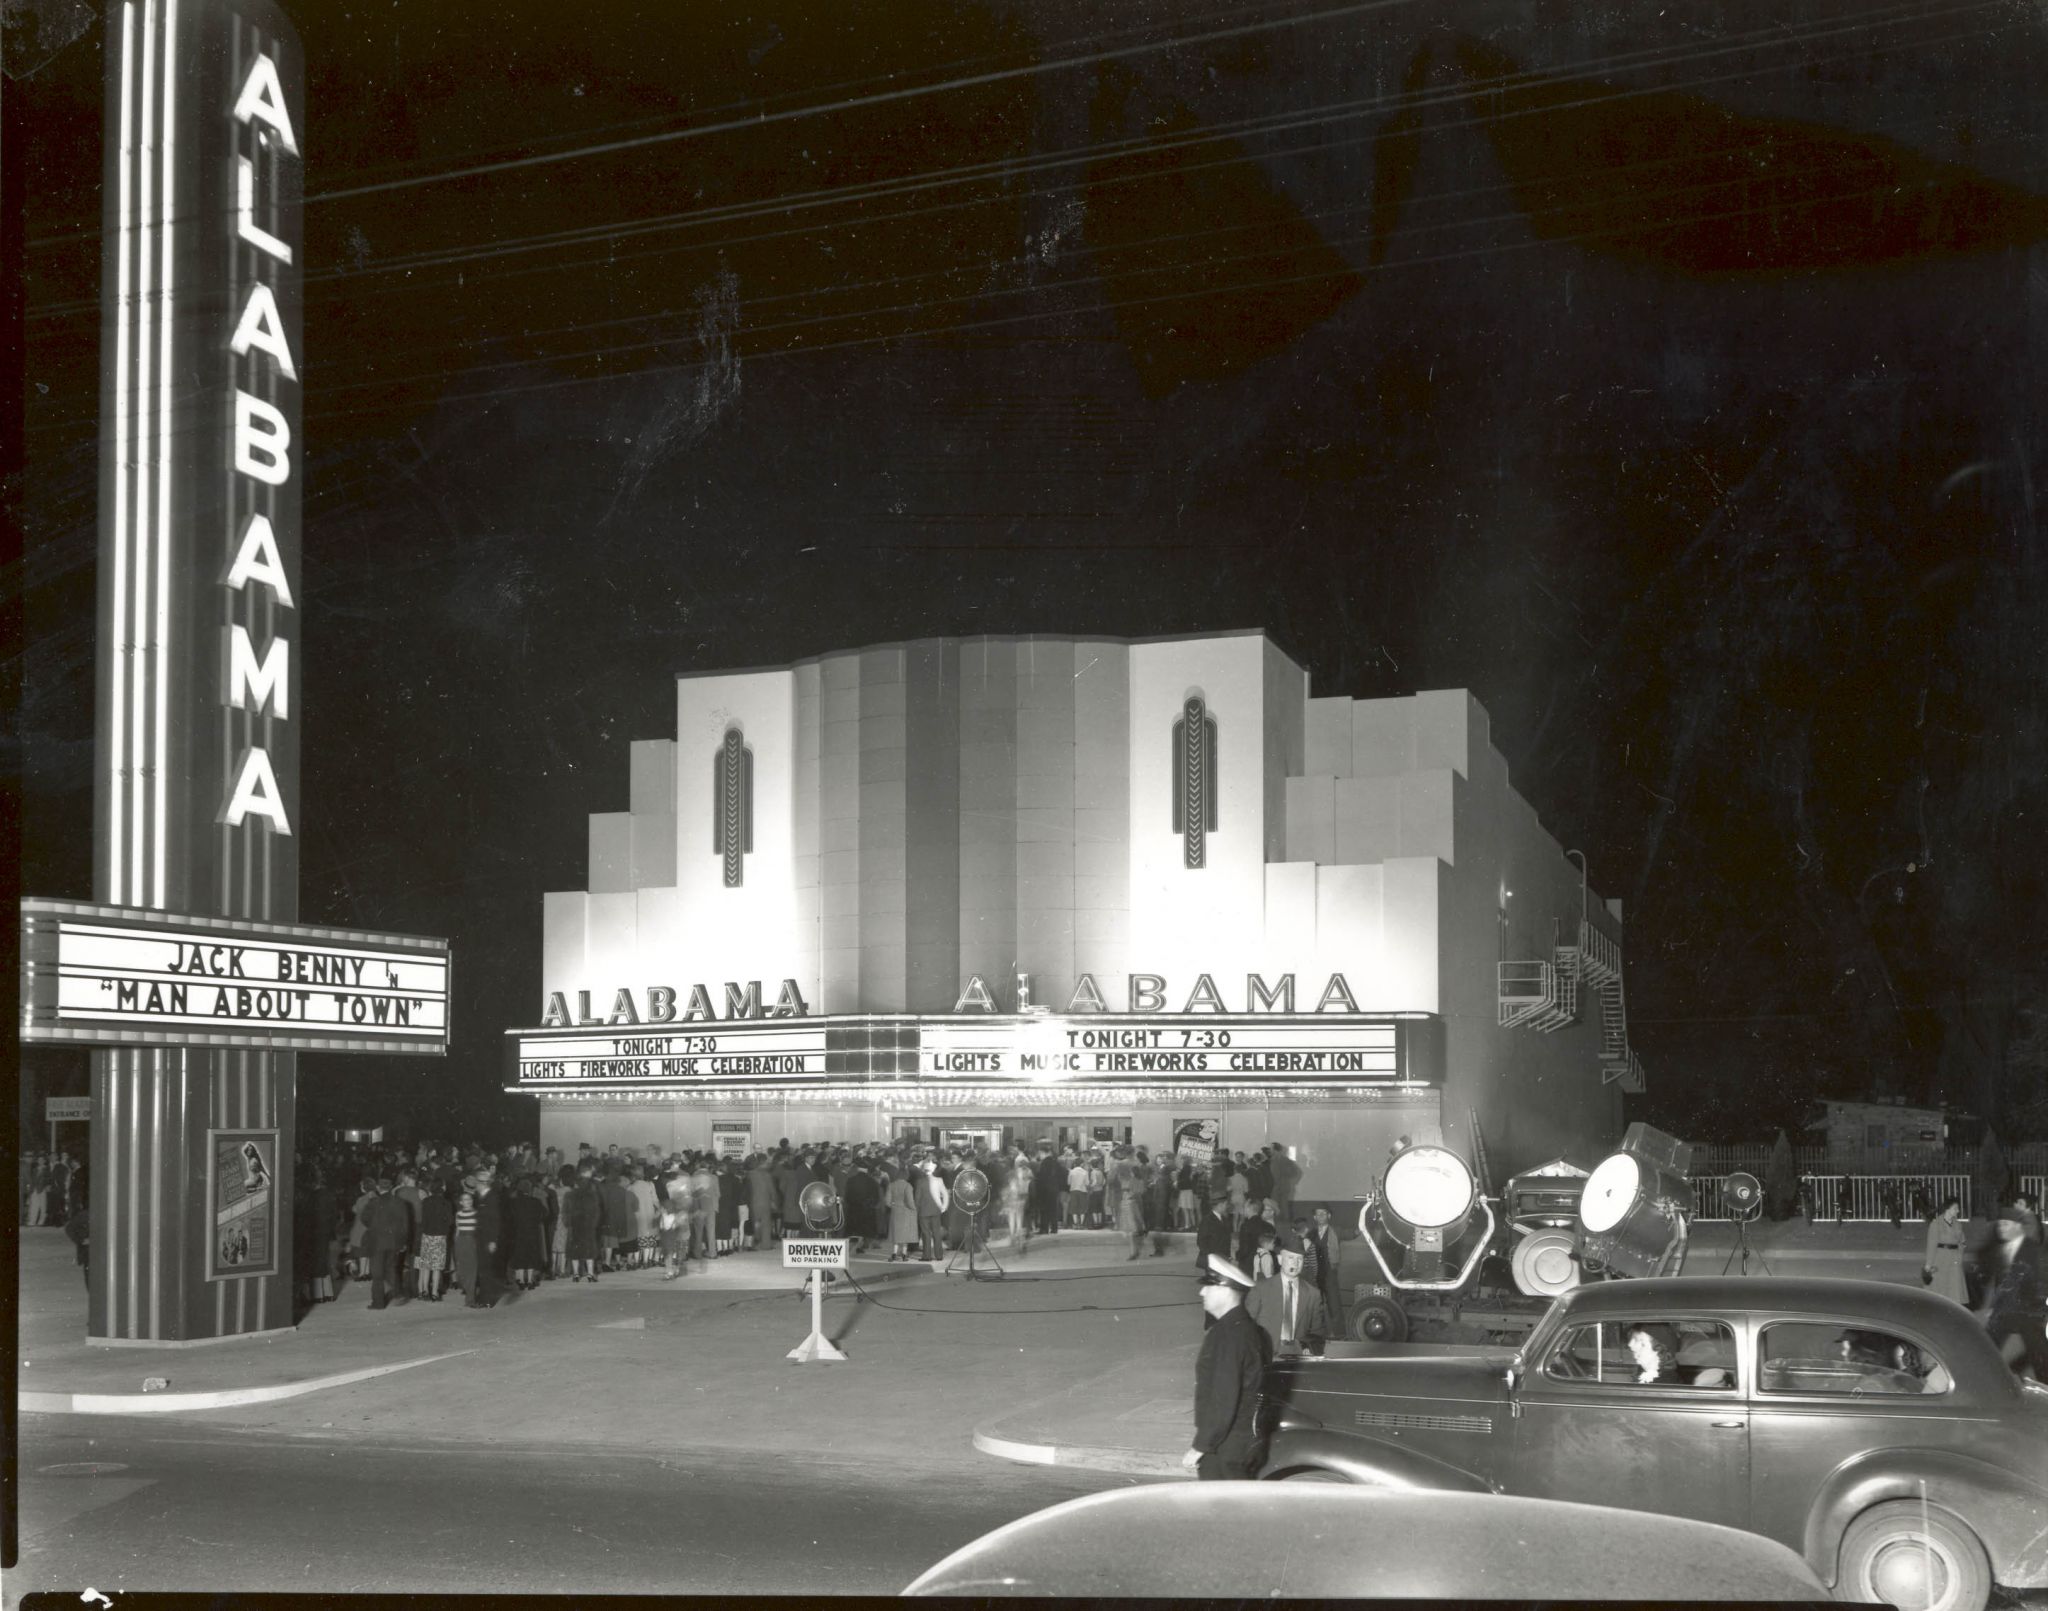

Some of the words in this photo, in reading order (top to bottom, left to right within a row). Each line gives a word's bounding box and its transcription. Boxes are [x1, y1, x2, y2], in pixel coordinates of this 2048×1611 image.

[225, 53, 300, 836] ALABAMA
[167, 942, 245, 977] JACK
[278, 951, 365, 986] BENNY
[212, 987, 310, 1020] ABOUT
[540, 979, 808, 1027] ALABAMA
[953, 973, 1360, 1014] ALABAMA
[612, 1038, 673, 1056] TONIGHT
[684, 1036, 717, 1054] 7-30
[1066, 1030, 1162, 1048] TONIGHT
[1180, 1030, 1231, 1048] 7-30
[523, 1061, 566, 1078] LIGHTS
[580, 1060, 650, 1077] FIREWORKS
[661, 1059, 699, 1076] MUSIC
[711, 1055, 805, 1074] CELEBRATION
[933, 1053, 1001, 1071] LIGHTS
[1020, 1053, 1081, 1071] MUSIC
[1095, 1053, 1208, 1071] FIREWORKS
[1230, 1053, 1363, 1071] CELEBRATION
[788, 1244, 843, 1256] DRIVEWAY
[804, 1256, 839, 1264] PARKING
